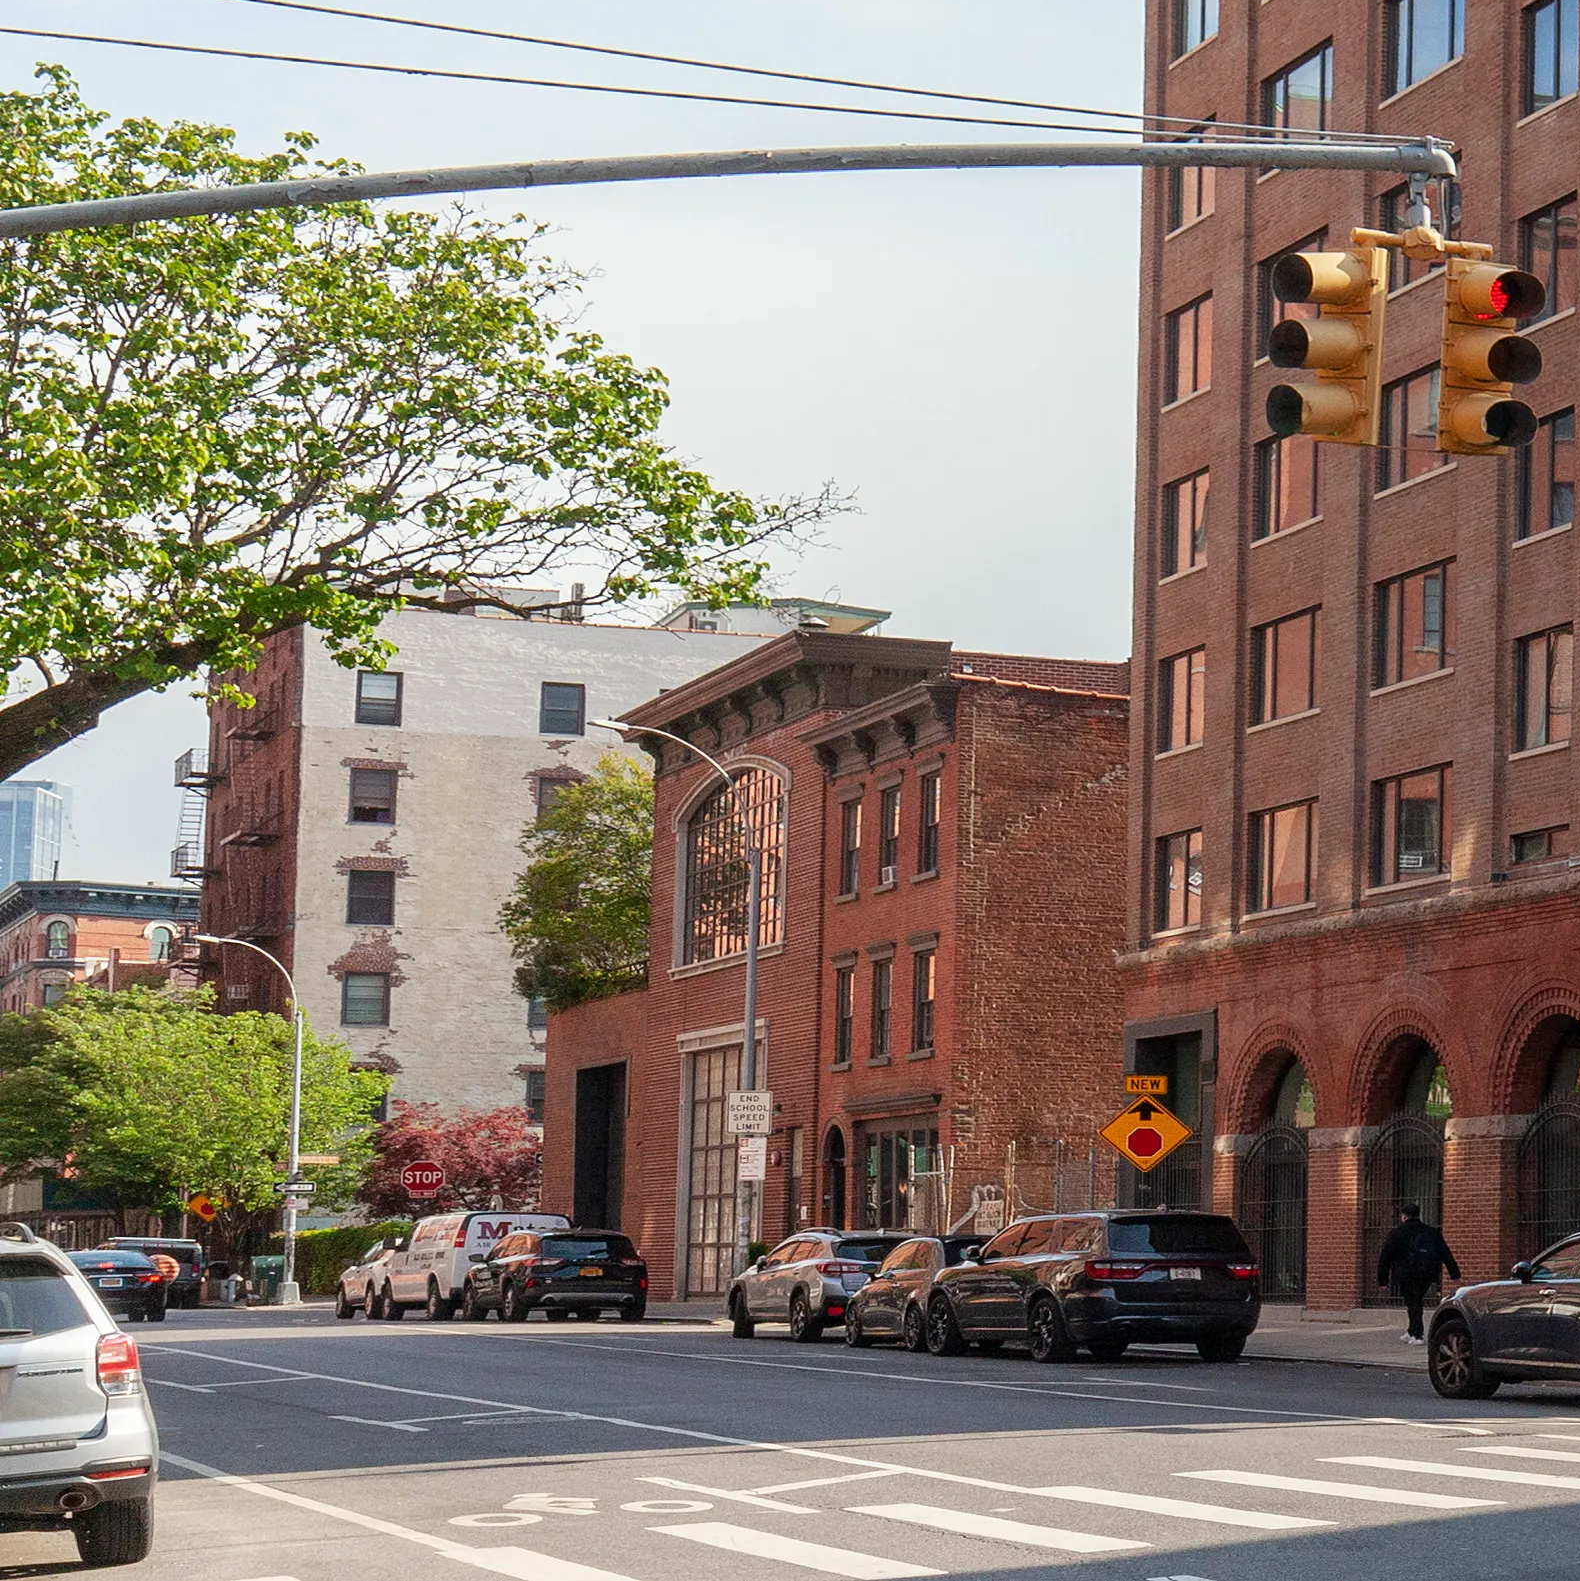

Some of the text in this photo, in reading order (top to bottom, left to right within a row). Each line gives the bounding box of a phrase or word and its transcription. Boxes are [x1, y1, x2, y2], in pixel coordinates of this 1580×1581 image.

[1130, 1079, 1161, 1090] NEW
[739, 1094, 760, 1103] END
[729, 1104, 770, 1112] SCHOOL
[733, 1113, 766, 1121] SPEED
[736, 1123, 761, 1131] LIMIT
[404, 1171, 443, 1184] STOP
